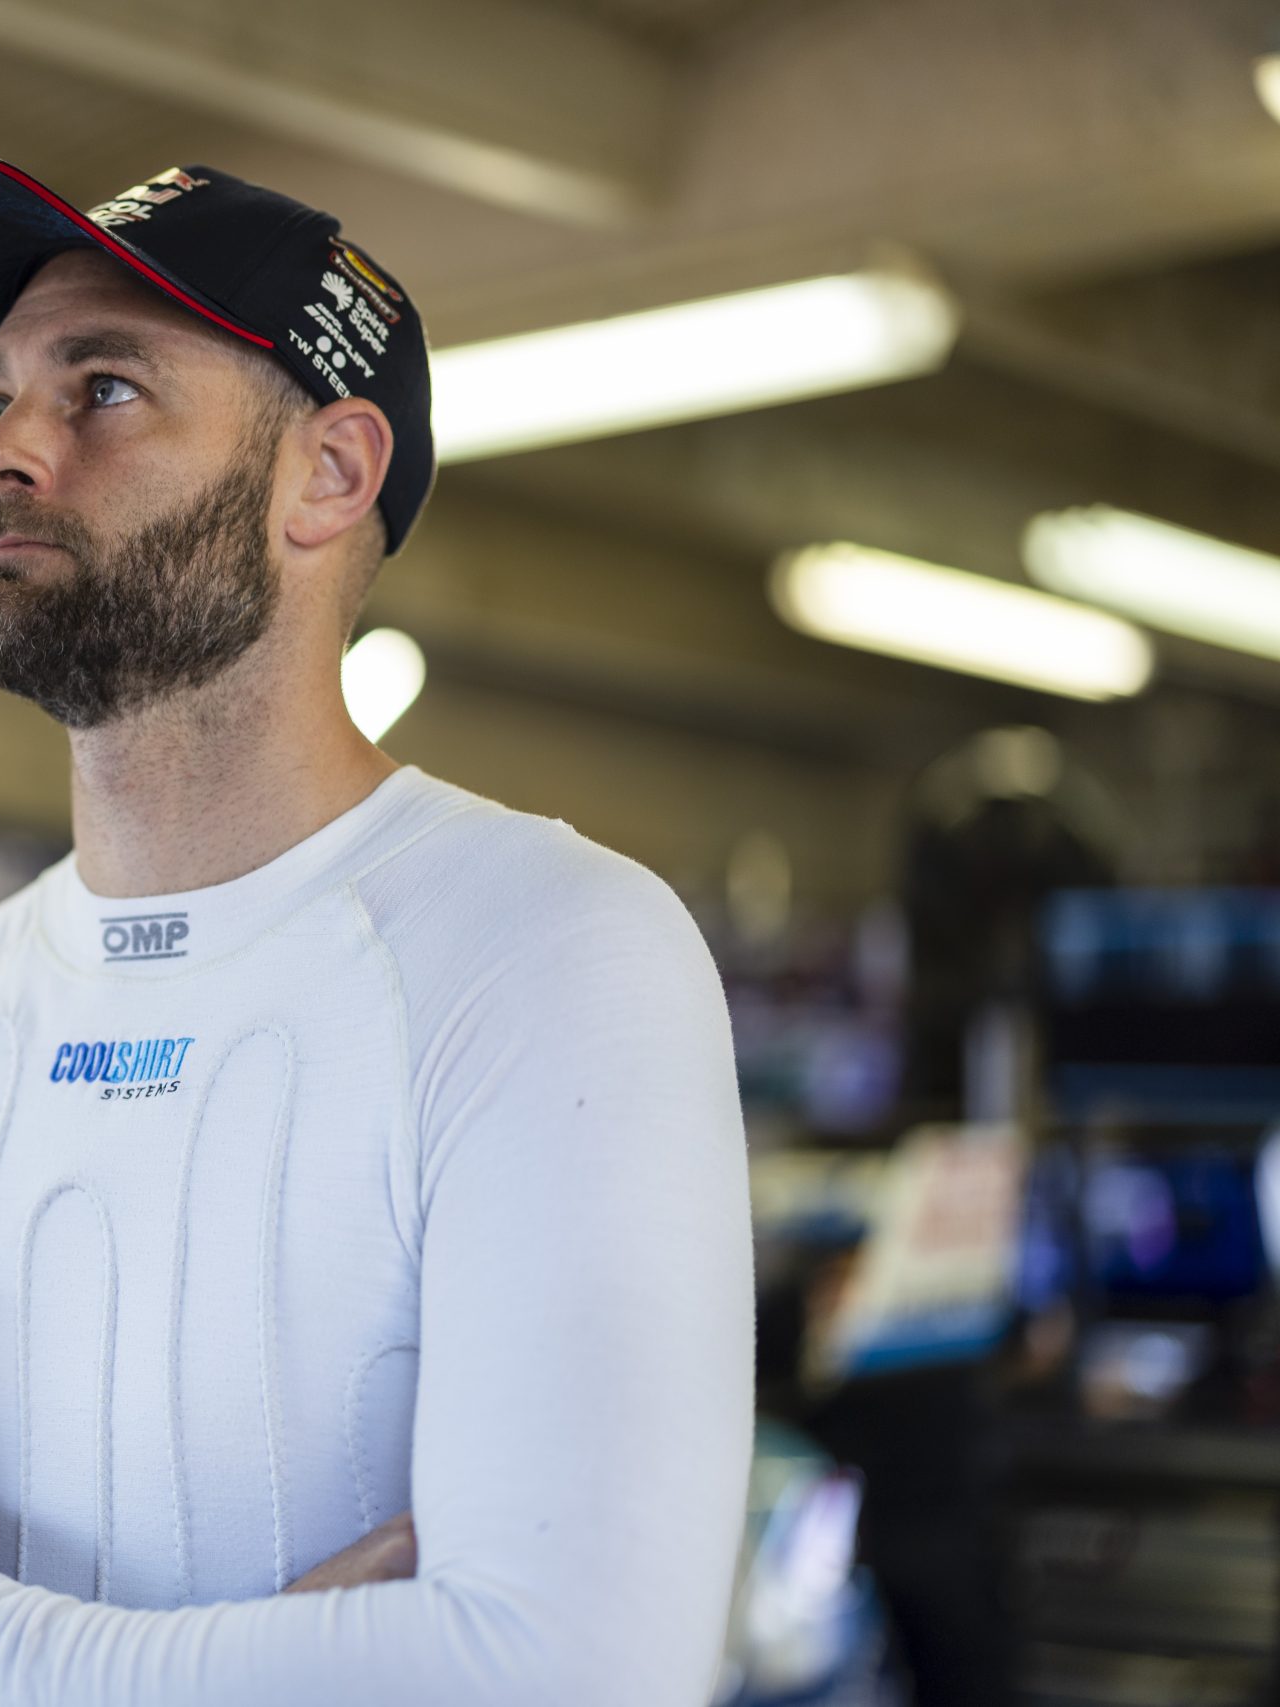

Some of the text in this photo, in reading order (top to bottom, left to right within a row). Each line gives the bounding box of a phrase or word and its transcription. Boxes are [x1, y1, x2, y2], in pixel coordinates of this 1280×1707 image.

[348, 309, 386, 355] Super
[355, 297, 389, 341] Spirit
[288, 329, 313, 355] TW
[314, 316, 375, 378] AMPLIFY
[103, 920, 189, 953] OMP
[50, 1037, 195, 1084] COOLSHIRT
[100, 1081, 180, 1100] SYSTEMS
